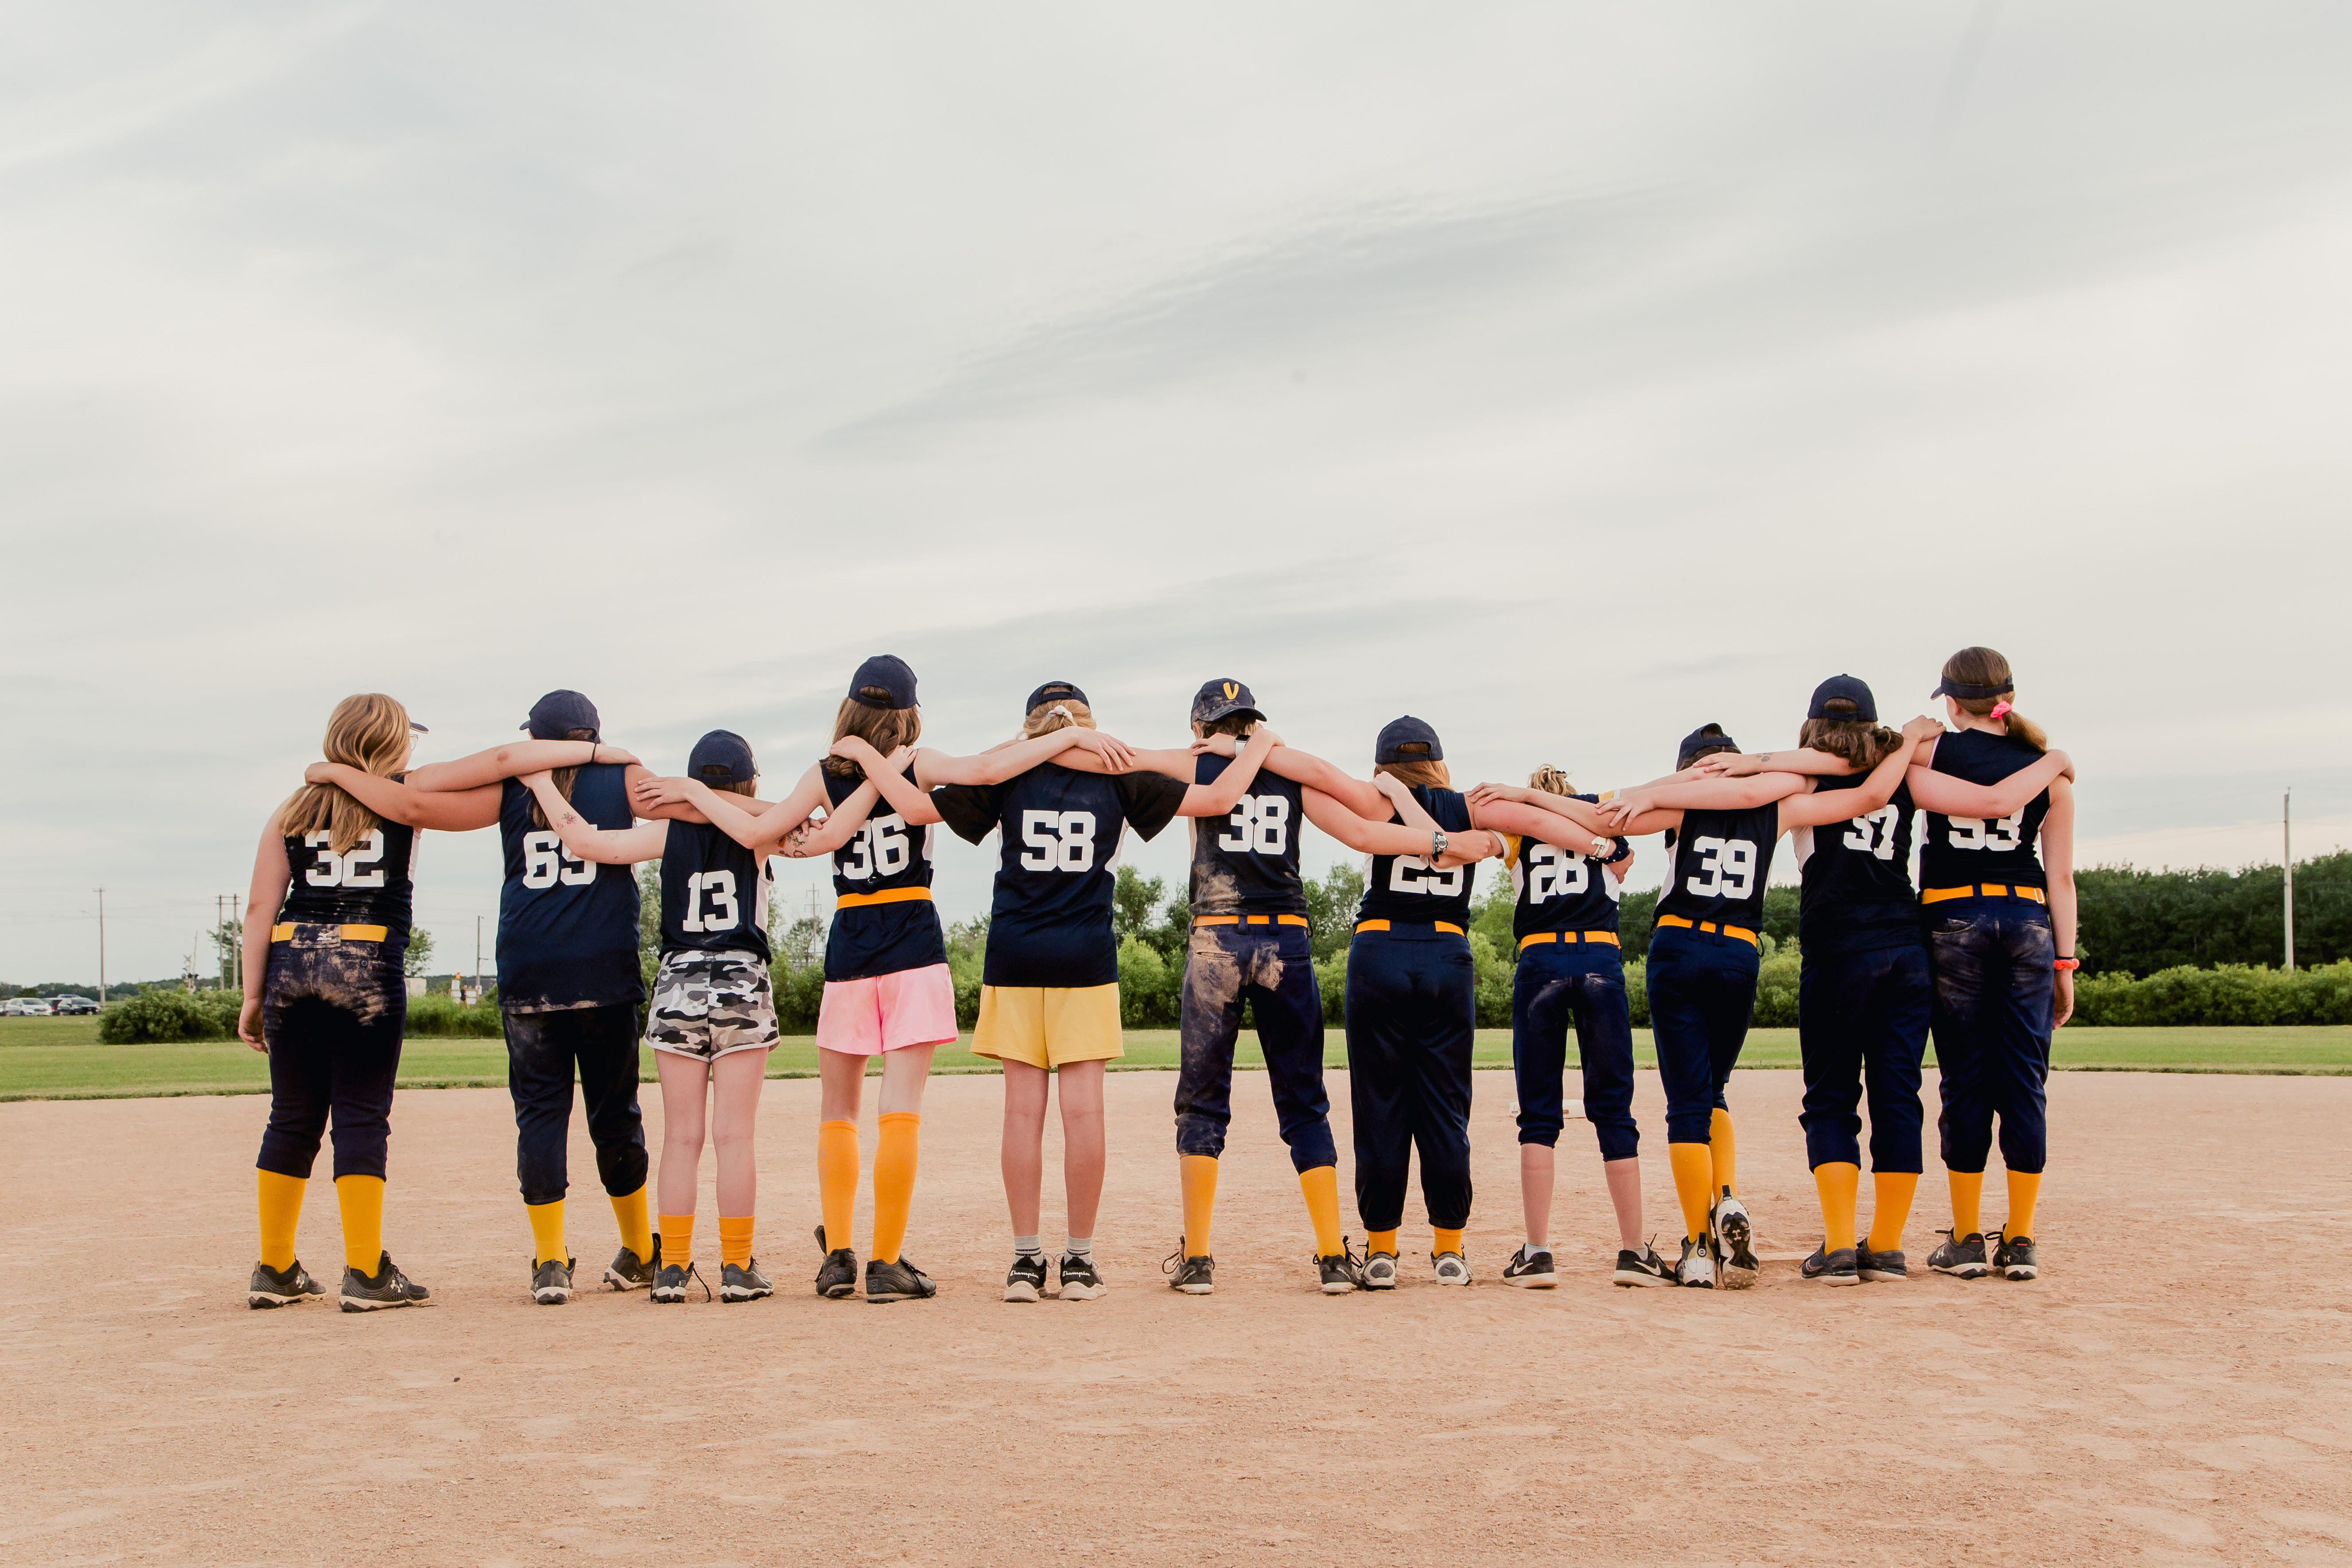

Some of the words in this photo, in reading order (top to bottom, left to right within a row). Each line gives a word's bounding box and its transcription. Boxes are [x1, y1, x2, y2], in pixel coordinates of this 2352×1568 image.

[1223, 682, 1239, 700] V
[843, 813, 909, 879] 36
[1021, 810, 1095, 872] 58
[1219, 794, 1289, 855] 38
[305, 829, 384, 887] 32
[1530, 844, 1588, 904] 28
[1687, 836, 1757, 899] 39
[683, 870, 739, 932] 13
[1010, 1270, 1039, 1279] Champion
